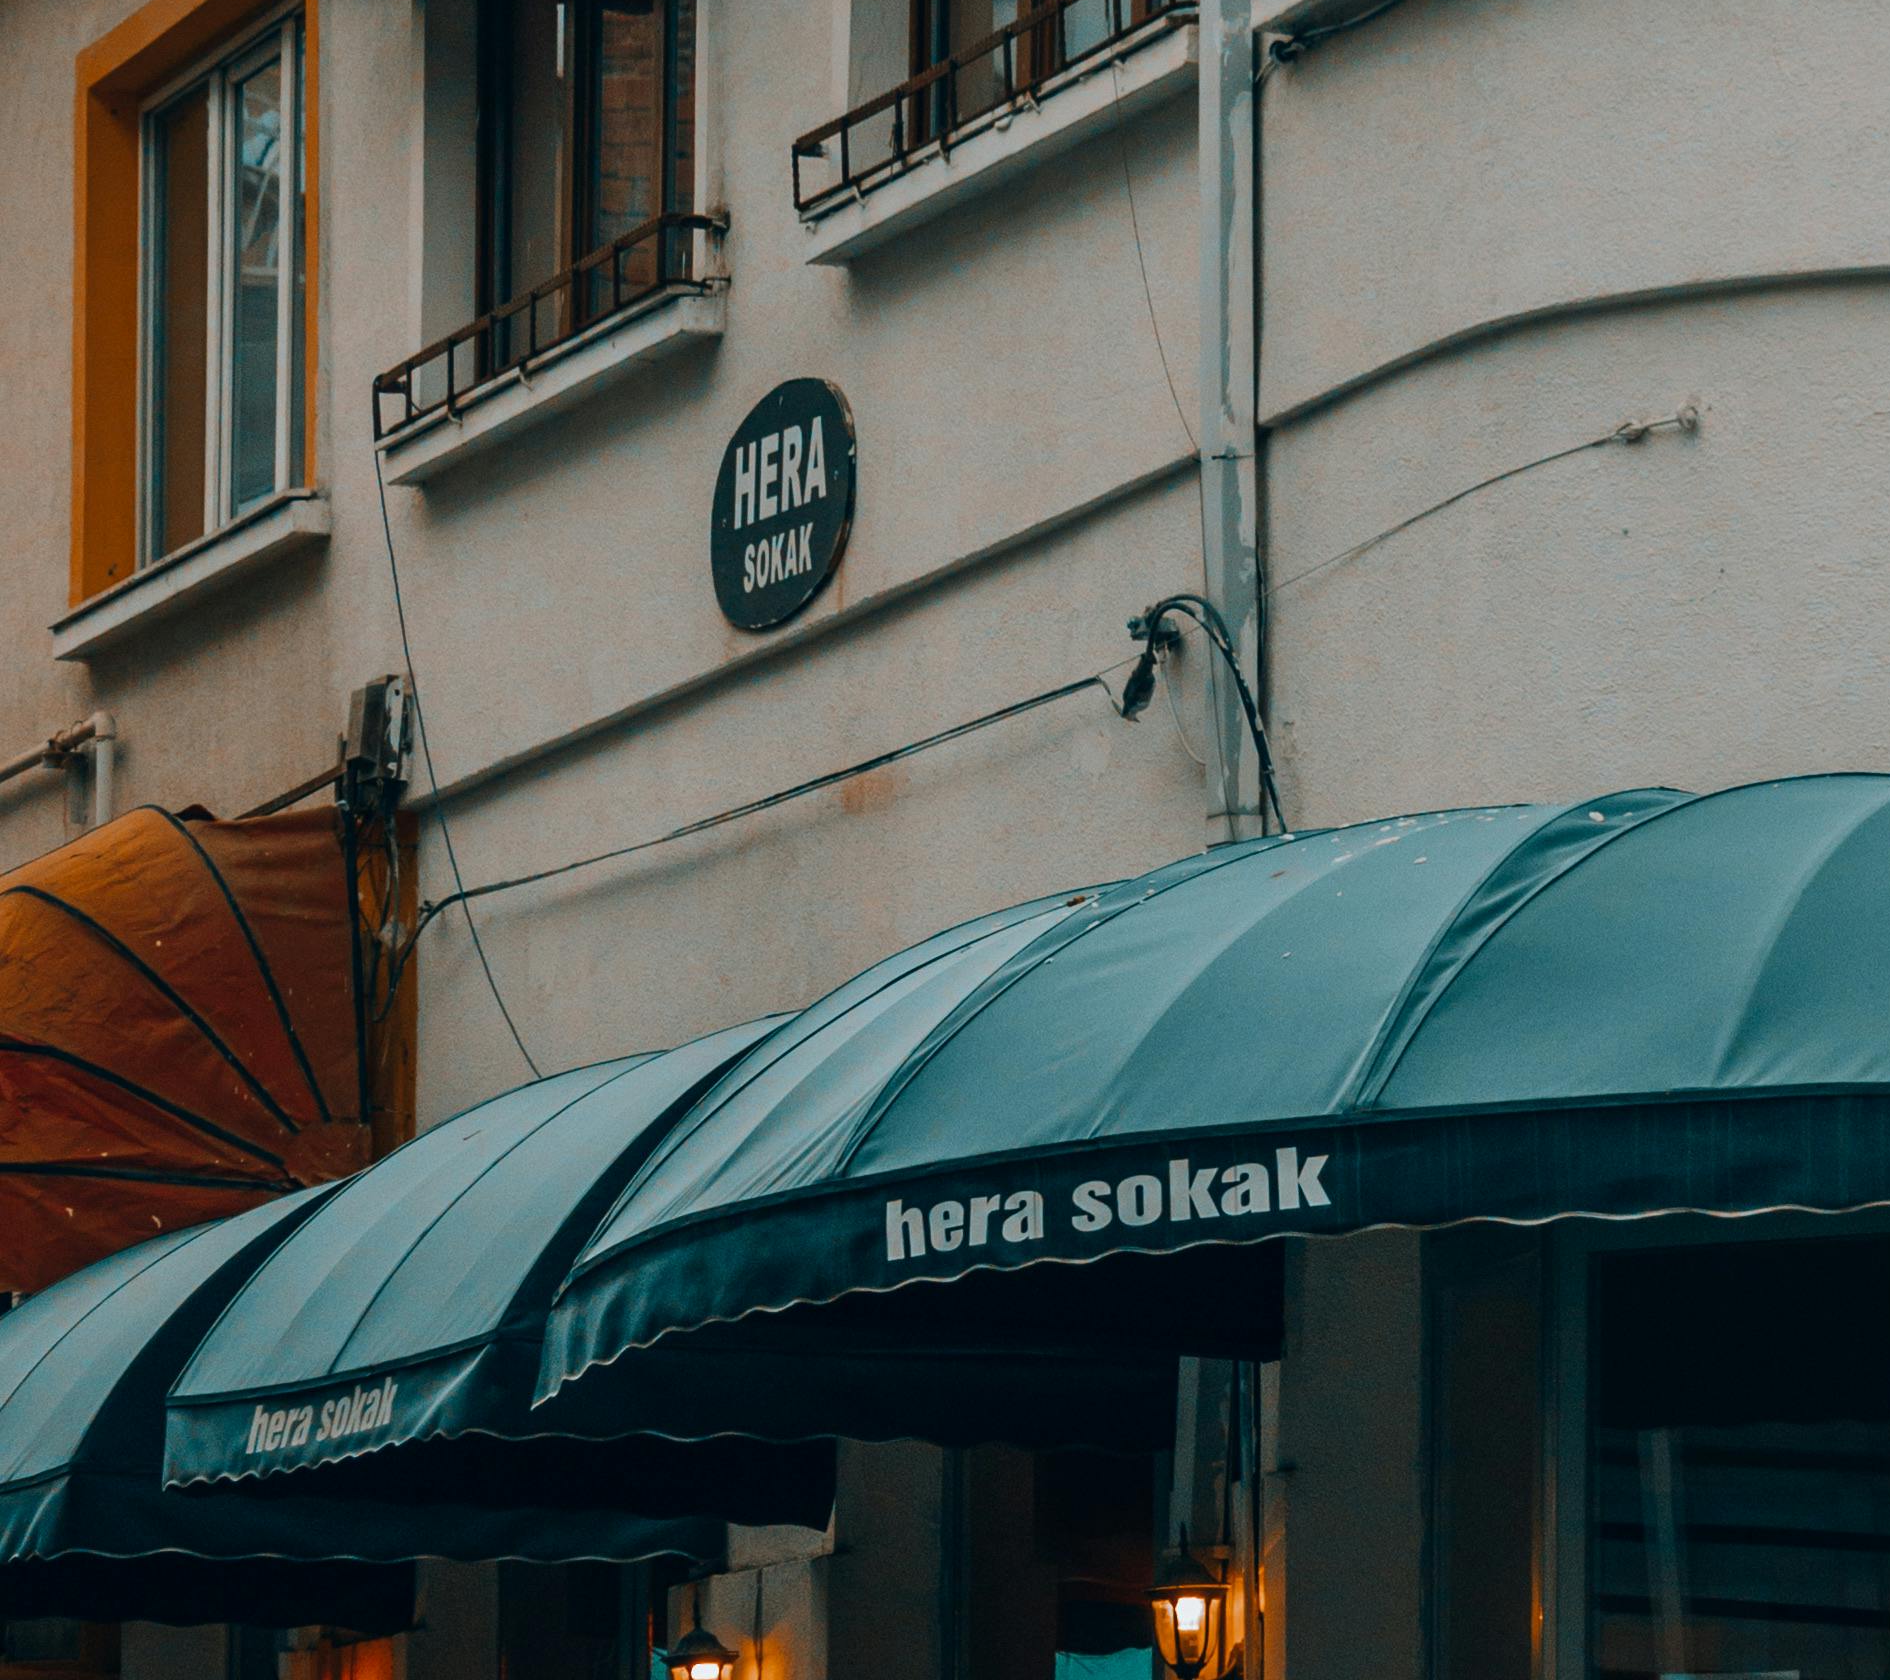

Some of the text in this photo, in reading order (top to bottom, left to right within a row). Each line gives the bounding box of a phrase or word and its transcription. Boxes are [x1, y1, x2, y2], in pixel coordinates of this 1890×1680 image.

[734, 415, 827, 530] HERA
[743, 522, 814, 594] SOKAK
[886, 1146, 1332, 1261] hera sokak
[245, 1376, 399, 1455] hera sokak
